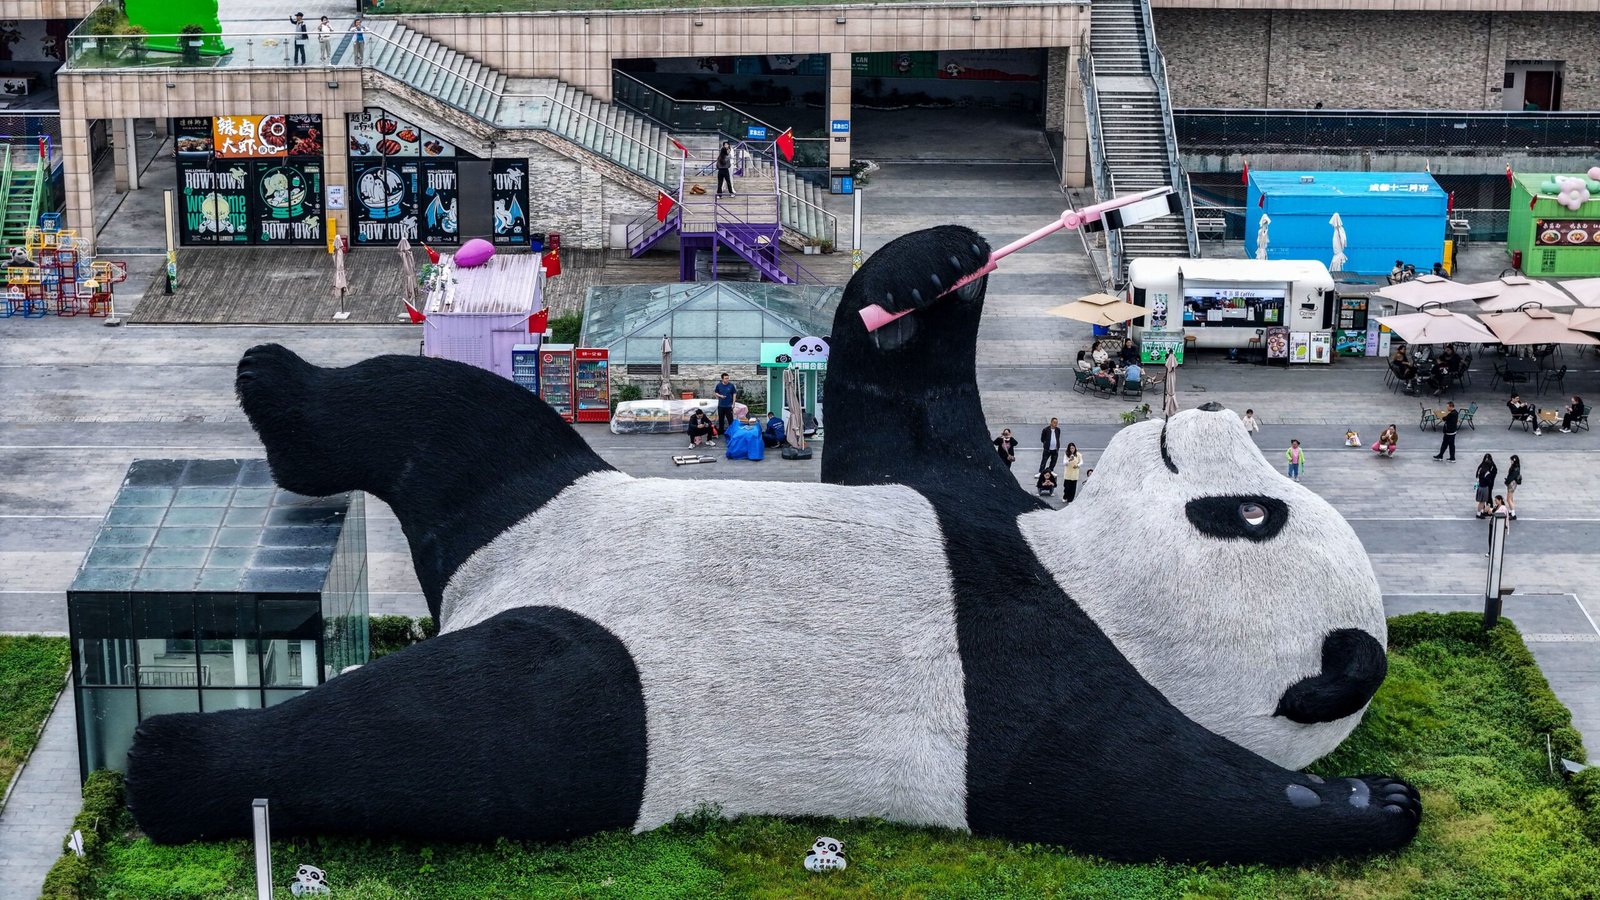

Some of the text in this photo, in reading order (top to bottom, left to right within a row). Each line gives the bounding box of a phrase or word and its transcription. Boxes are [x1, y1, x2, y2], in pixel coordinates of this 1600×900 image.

[217, 117, 255, 138] 辣卤
[222, 137, 257, 155] 大虾
[1369, 184, 1429, 192] 成都十二月市
